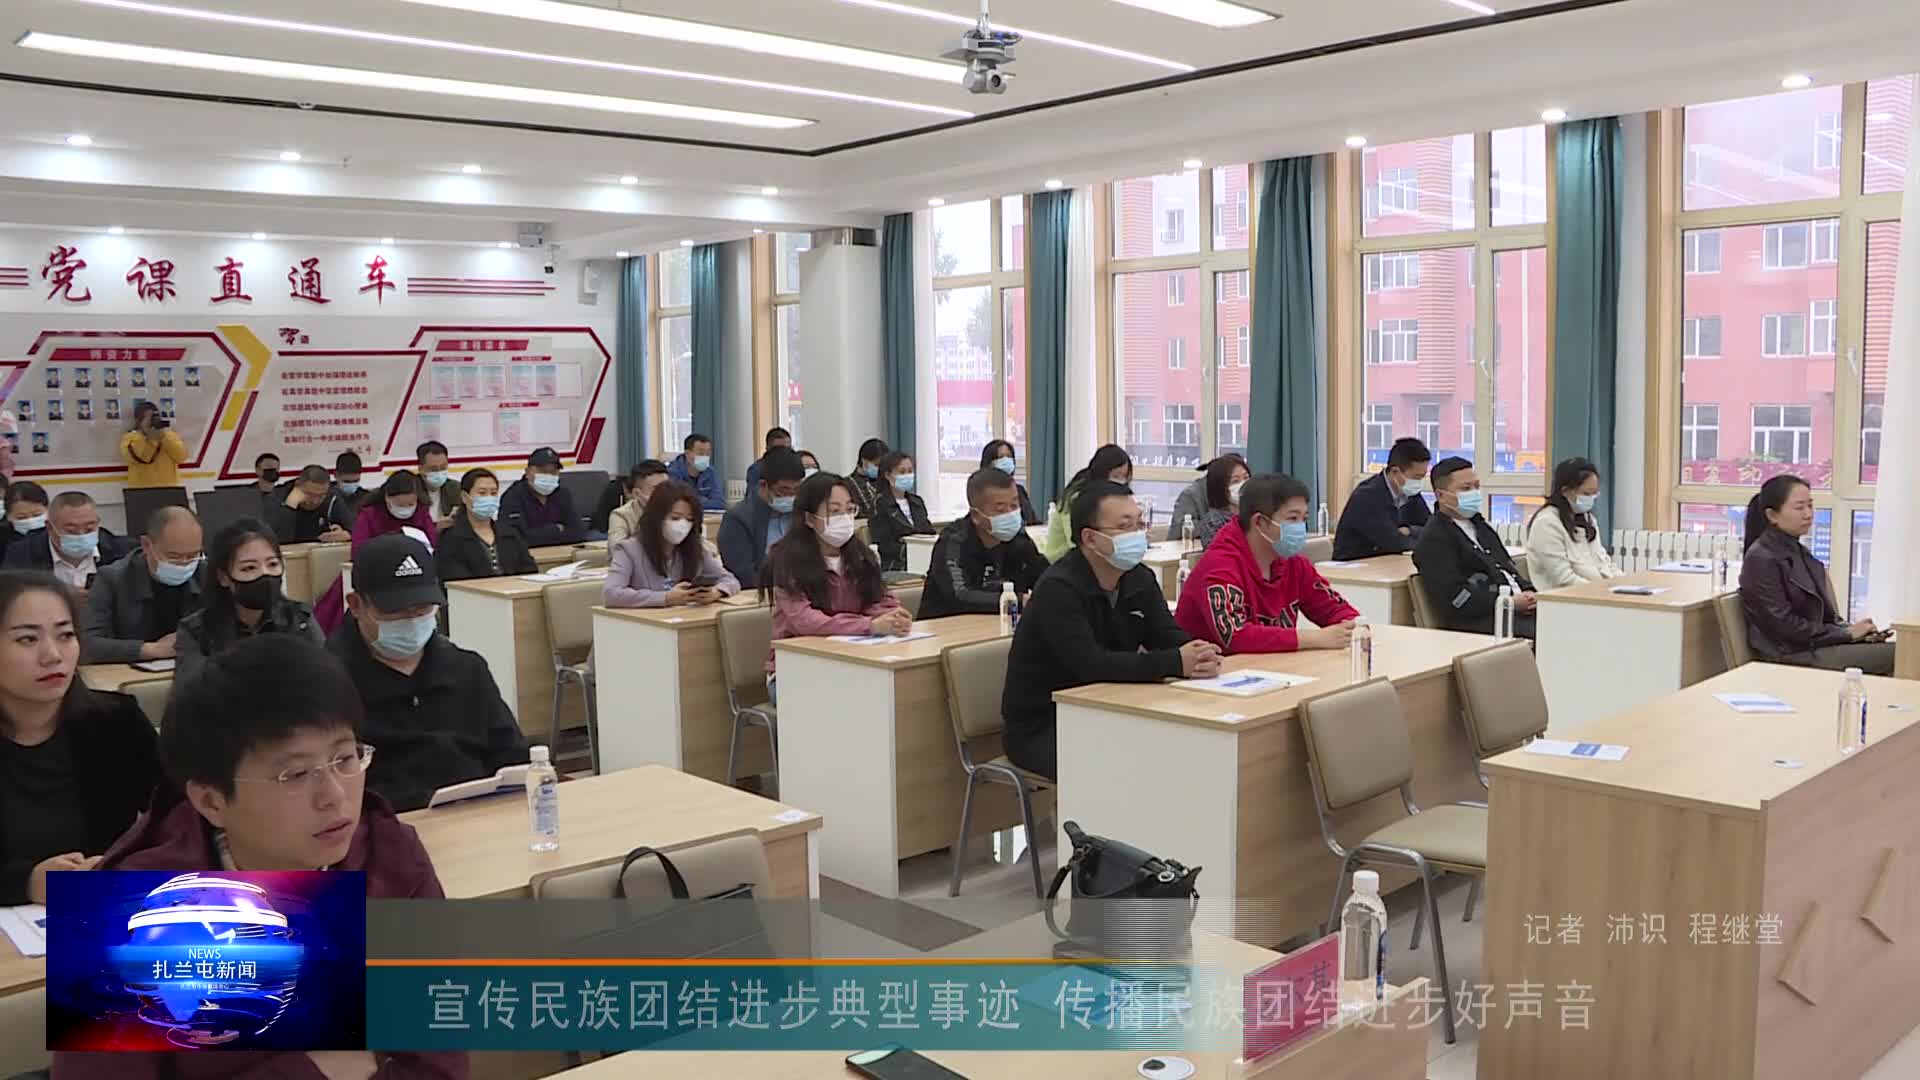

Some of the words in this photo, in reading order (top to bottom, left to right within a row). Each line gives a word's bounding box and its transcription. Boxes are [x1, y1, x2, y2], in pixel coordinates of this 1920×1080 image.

[42, 245, 396, 304] 党课直通车
